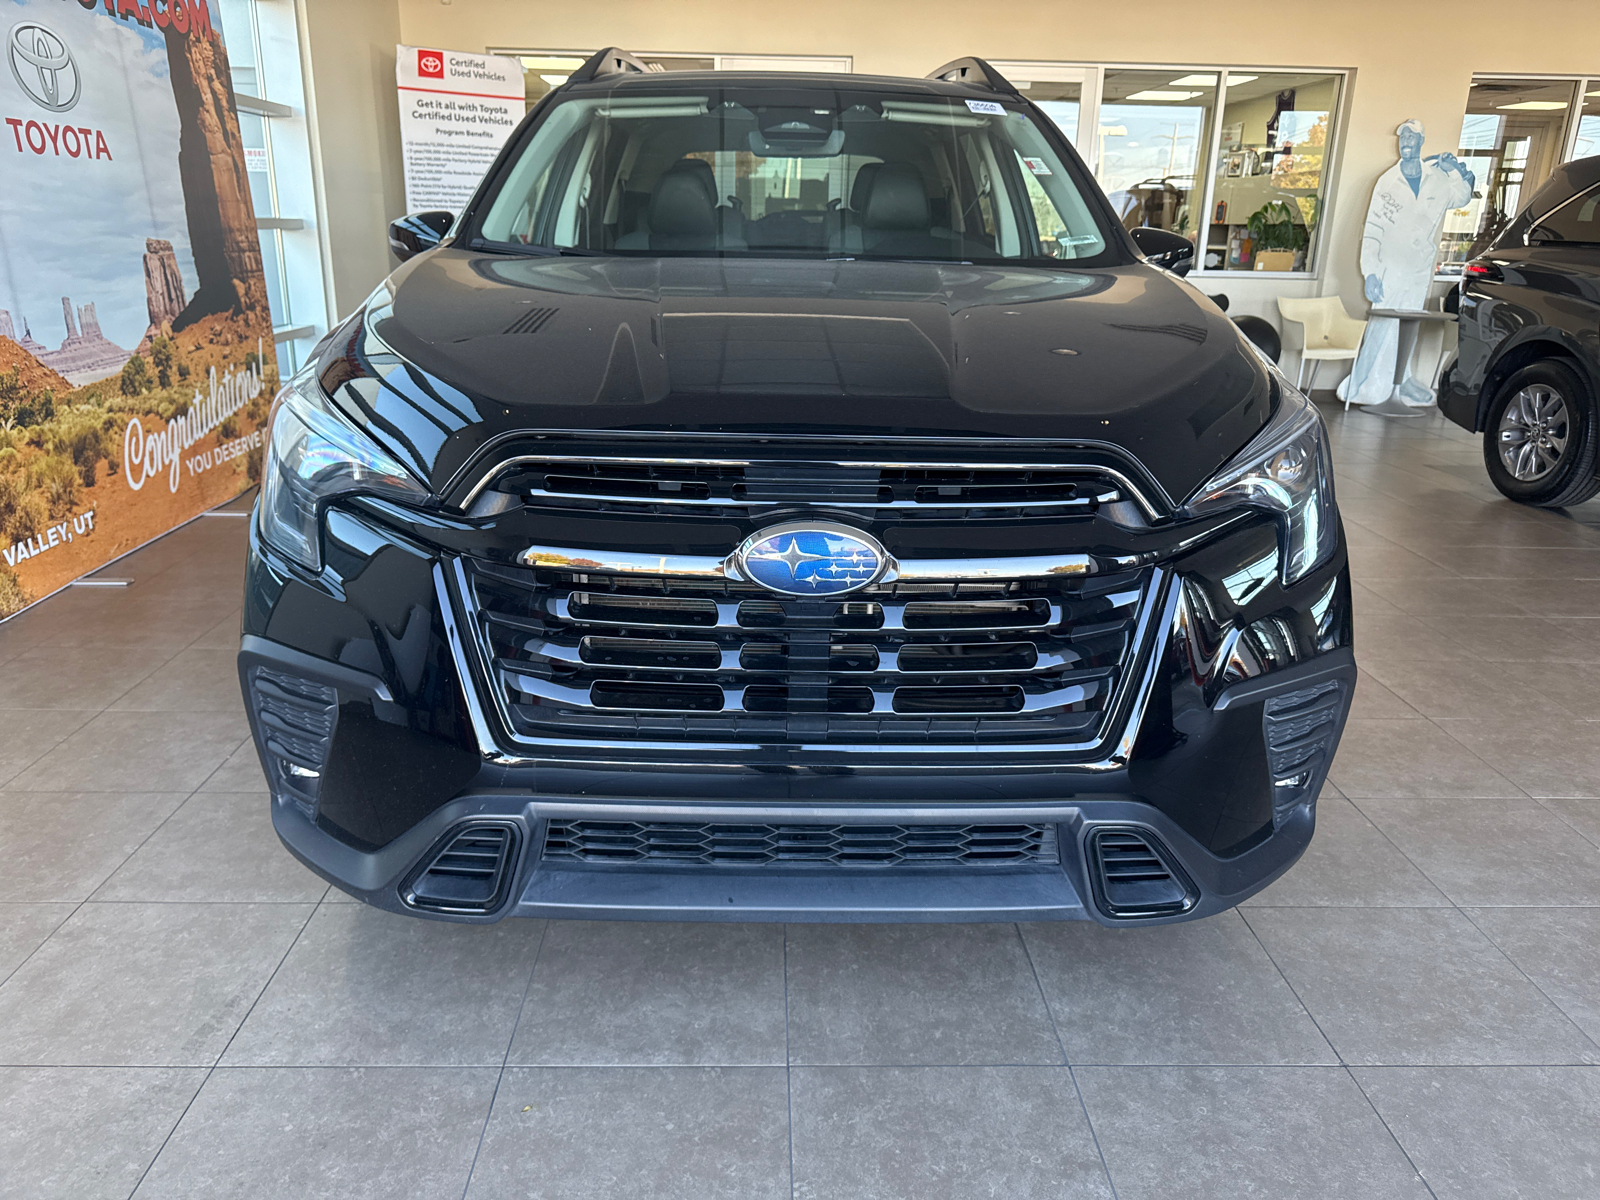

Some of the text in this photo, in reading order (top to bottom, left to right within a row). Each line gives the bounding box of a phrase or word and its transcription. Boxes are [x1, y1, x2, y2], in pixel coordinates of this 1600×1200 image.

[449, 57, 486, 69] Certified
[450, 68, 506, 82] Used Vehicles
[416, 99, 508, 115] Get it all with Toyota
[411, 110, 514, 126] Certified Used Vehicles
[5, 117, 113, 161] TOYOTA
[435, 127, 494, 138] Program Benefits
[124, 336, 265, 494] Congratulations!
[185, 455, 213, 477] YOU
[214, 431, 262, 466] DESERVE
[1, 510, 94, 568] VALLEY, UT
